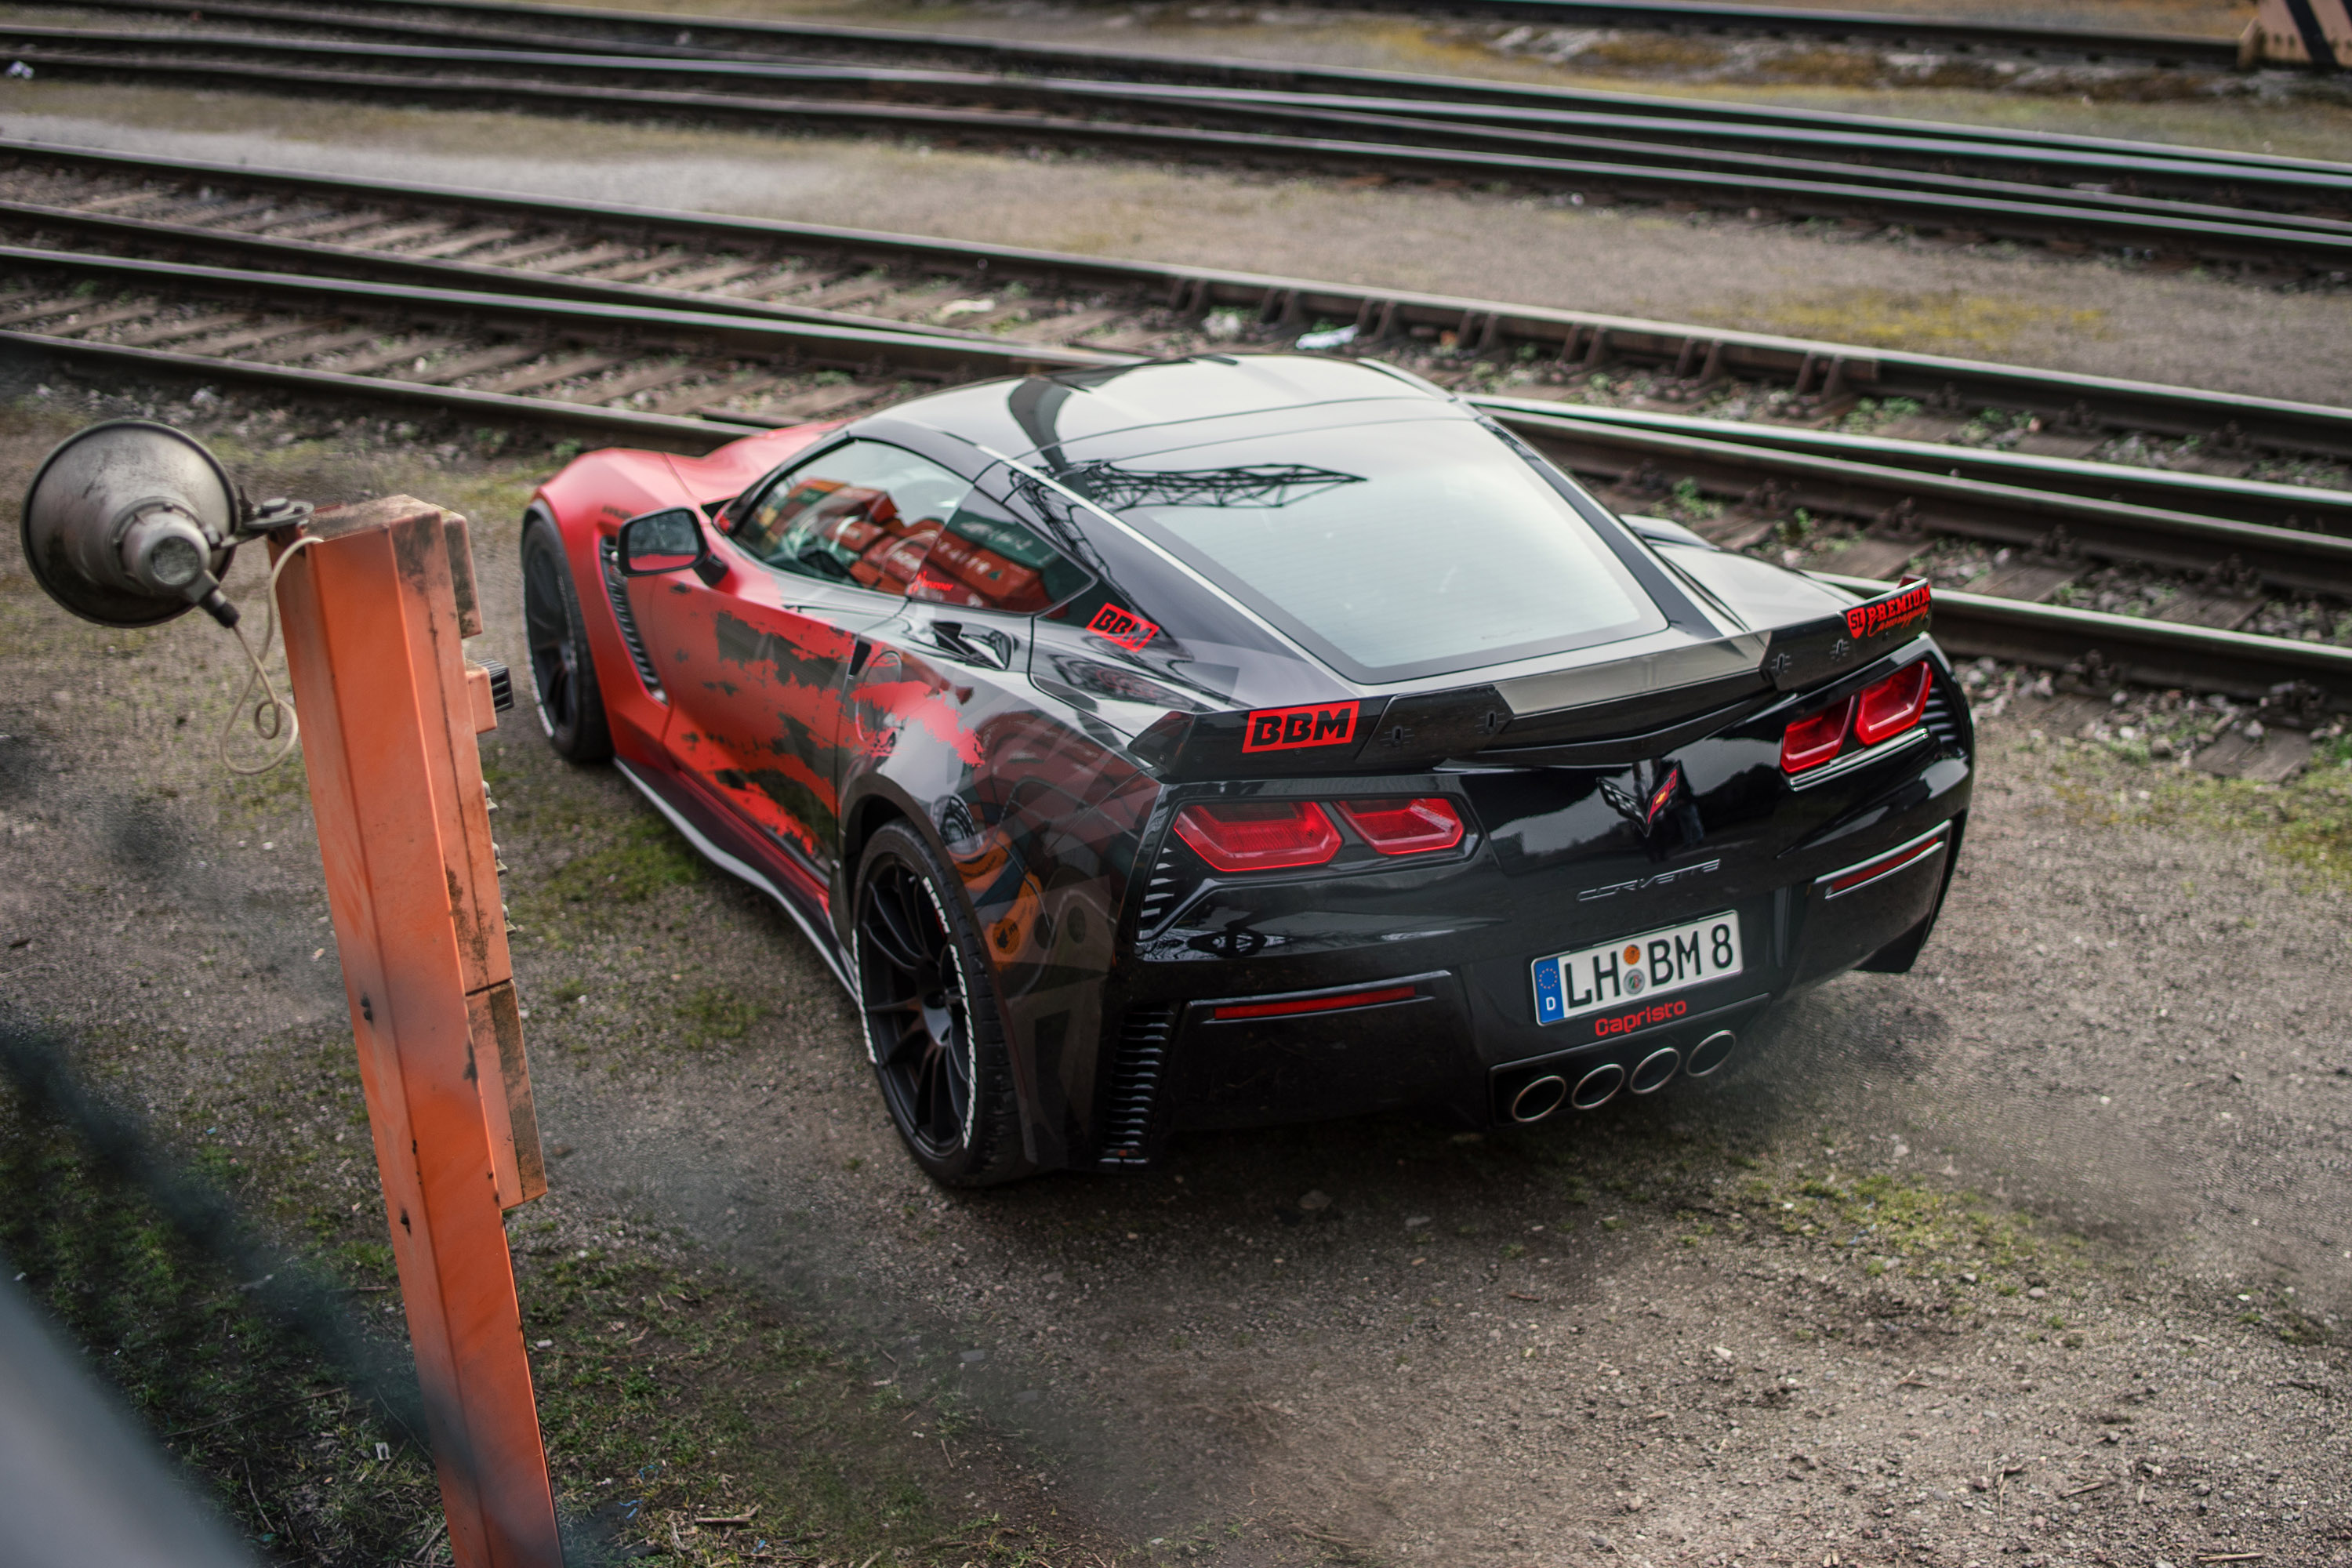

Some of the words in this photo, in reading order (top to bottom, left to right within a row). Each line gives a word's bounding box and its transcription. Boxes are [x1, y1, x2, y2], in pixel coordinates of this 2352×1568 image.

[1866, 584, 1931, 626] PREMIUM
[1091, 607, 1153, 647] BBM
[1250, 707, 1353, 747] BBM
[922, 876, 951, 934] BBM
[1564, 950, 1621, 1009] LH
[1646, 930, 1702, 988] BM
[1710, 923, 1733, 969] 8
[1545, 996, 1557, 1011] D
[1594, 1000, 1687, 1036] Capristo
